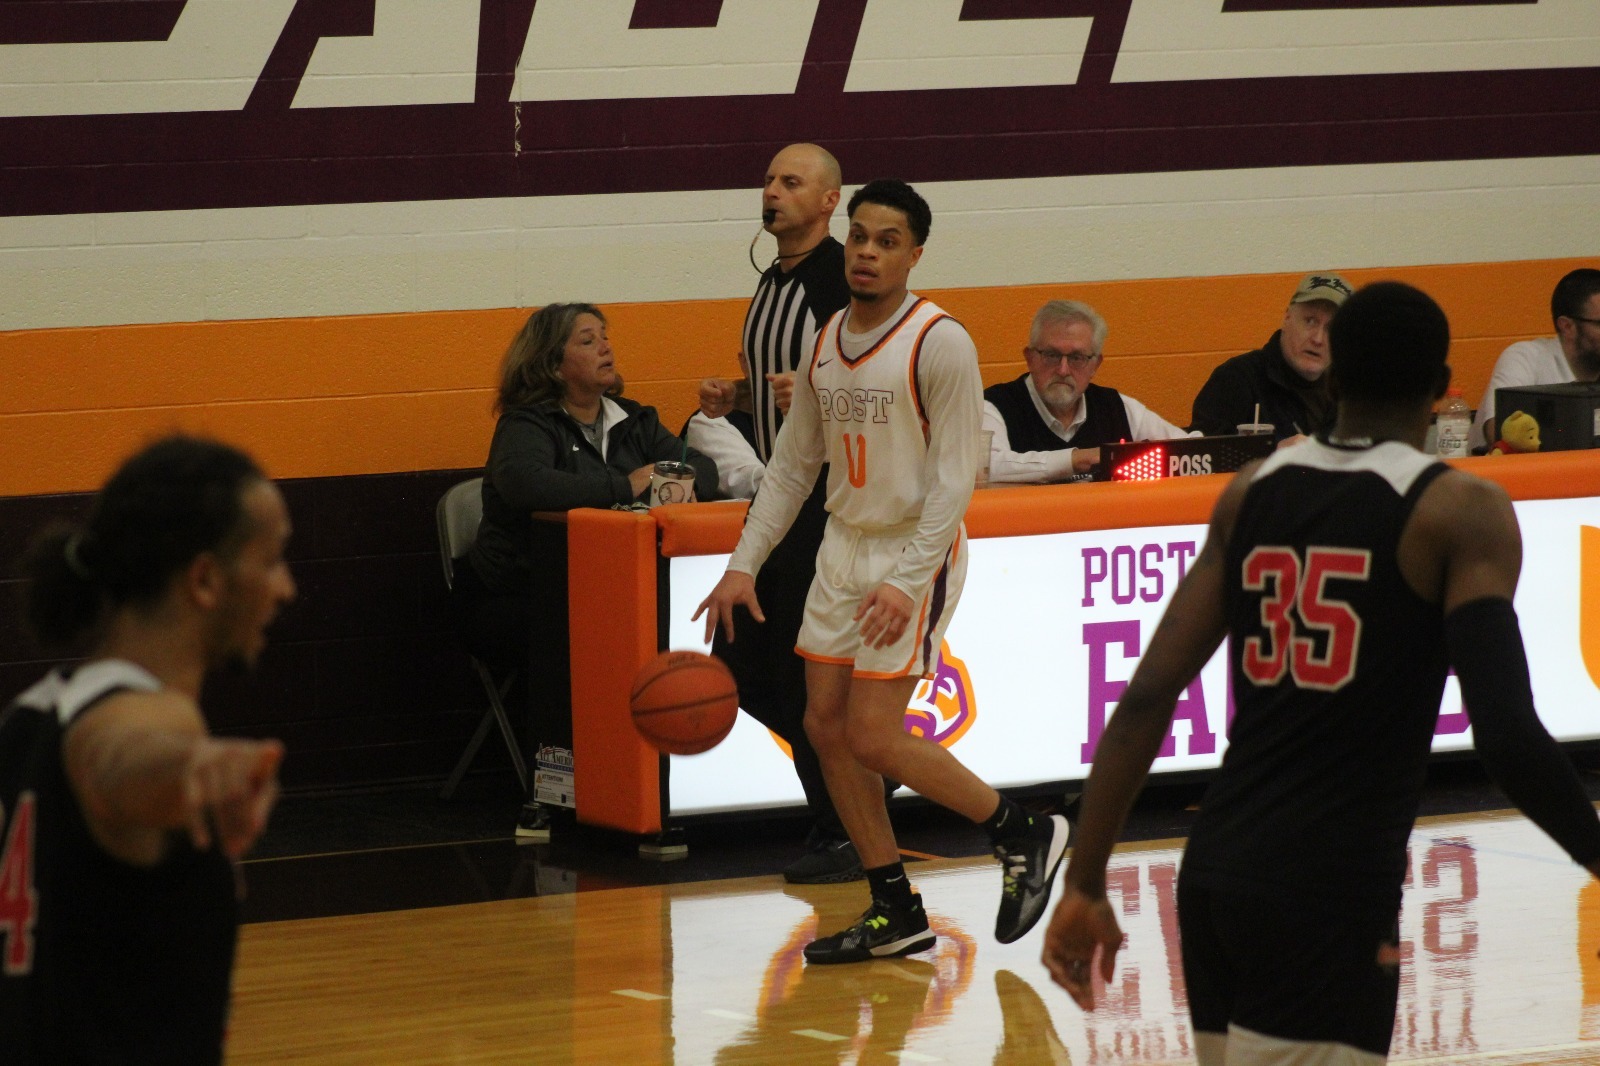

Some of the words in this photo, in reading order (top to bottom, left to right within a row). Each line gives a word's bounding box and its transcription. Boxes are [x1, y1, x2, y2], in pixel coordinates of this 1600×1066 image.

[818, 388, 893, 423] POST
[1081, 541, 1196, 607] POST
[1242, 546, 1371, 692] 35
[0, 792, 38, 975] 4
